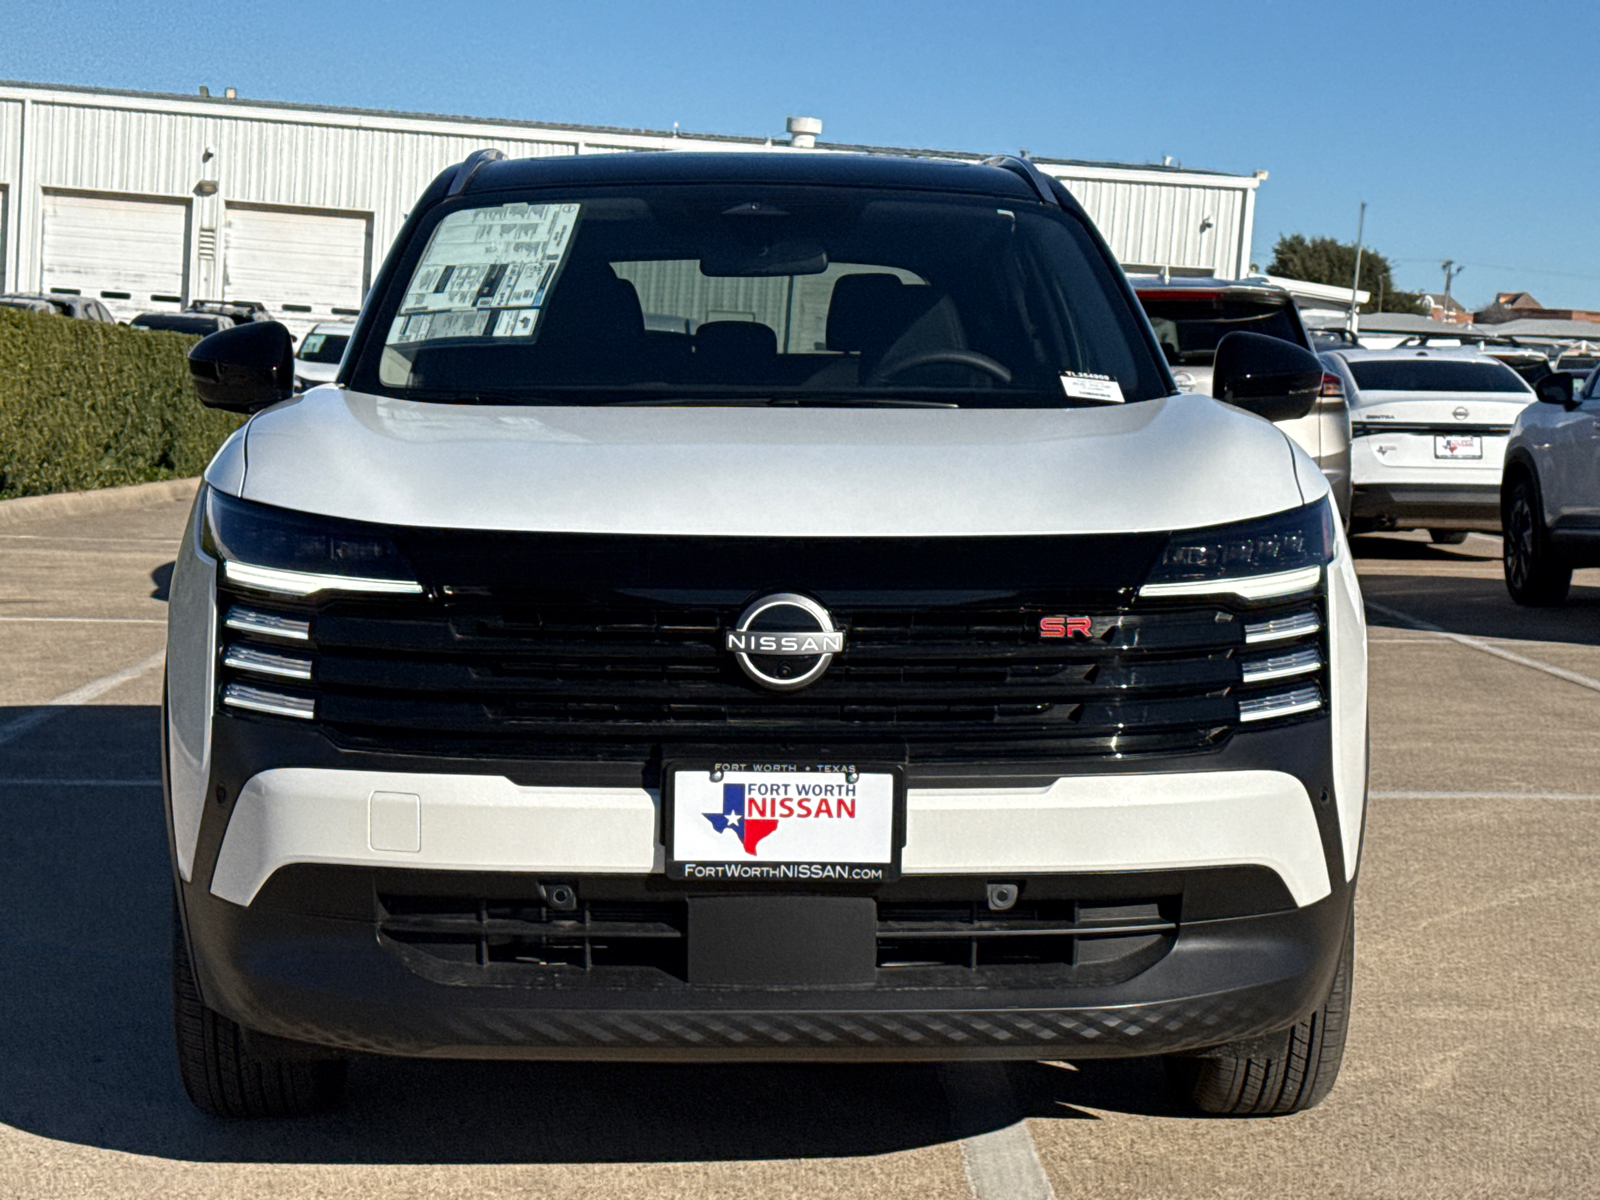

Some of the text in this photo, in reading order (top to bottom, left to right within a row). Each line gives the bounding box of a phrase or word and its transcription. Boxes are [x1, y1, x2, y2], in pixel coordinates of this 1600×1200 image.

[1040, 617, 1092, 637] SR
[728, 634, 840, 651] NISSAN
[714, 763, 747, 771] FORT
[817, 764, 857, 772] TEXAS
[747, 783, 856, 797] FORT WORTH
[747, 797, 856, 818] NISSAN
